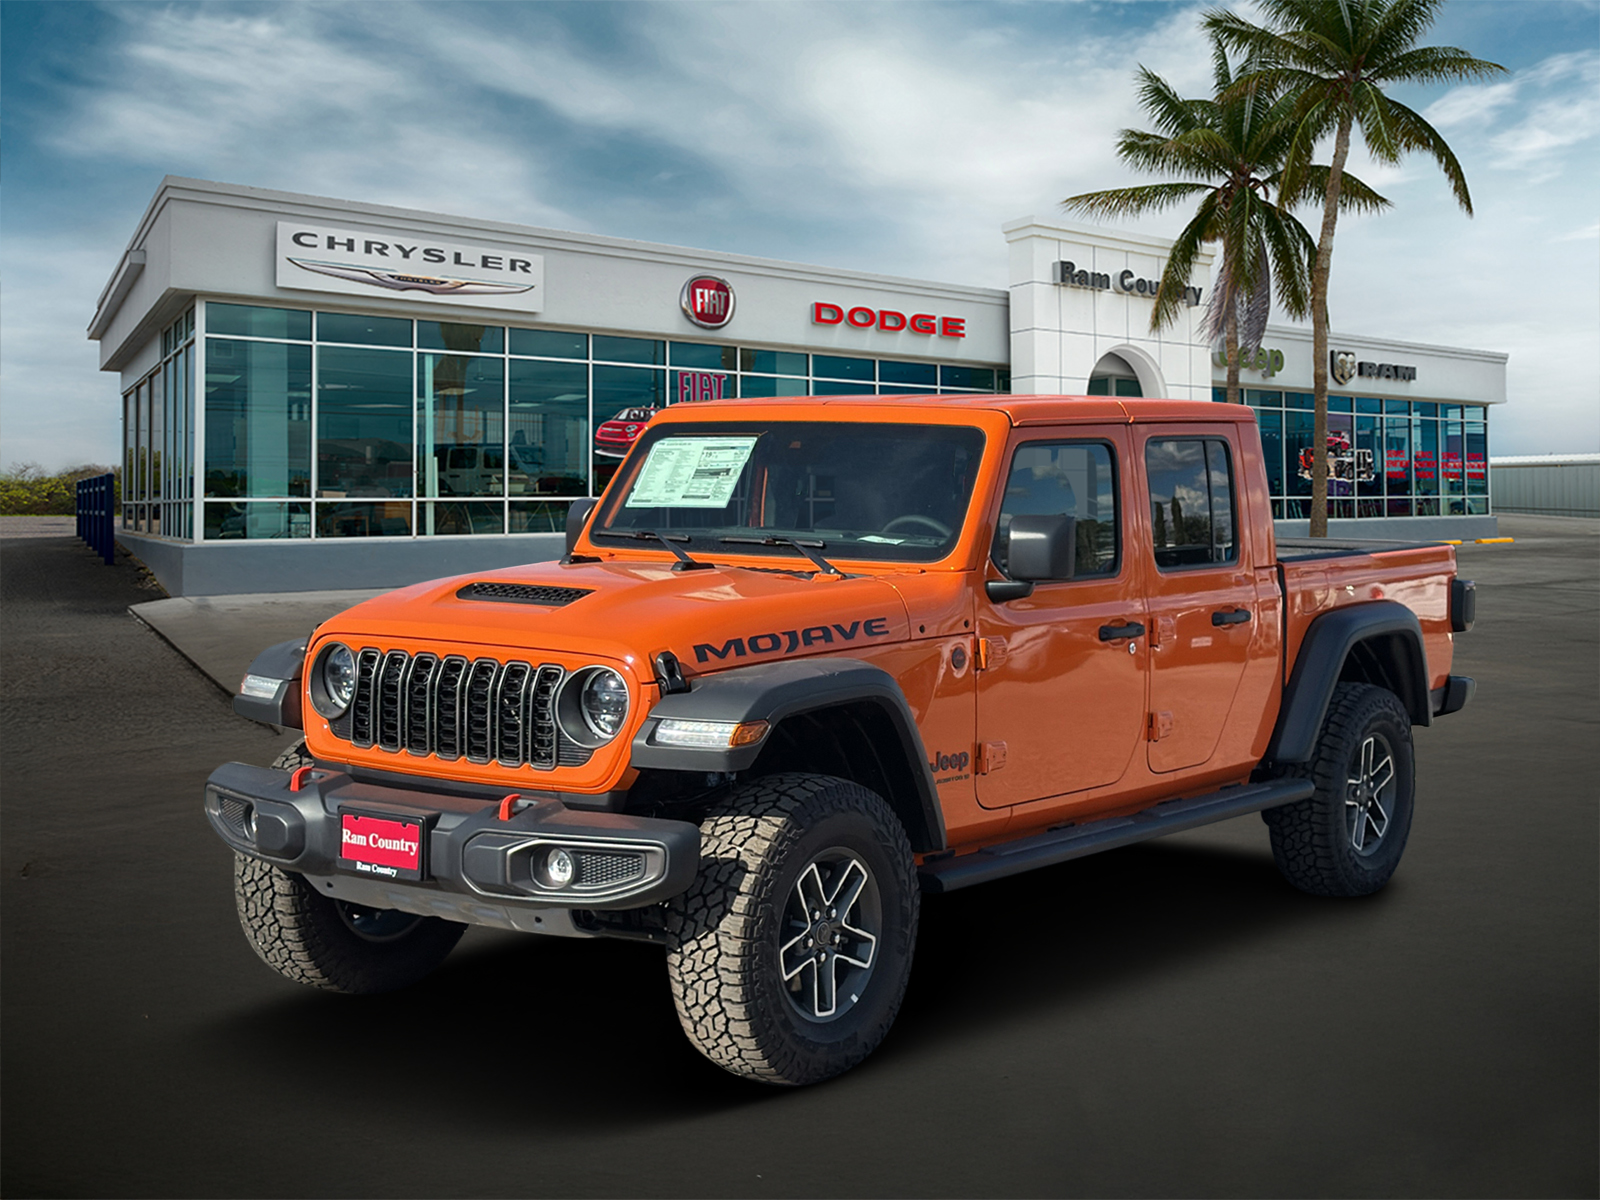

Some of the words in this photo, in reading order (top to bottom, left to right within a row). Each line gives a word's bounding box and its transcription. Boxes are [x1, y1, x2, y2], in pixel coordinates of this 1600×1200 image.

[292, 232, 532, 274] CHRYSLER
[1056, 260, 1110, 290] Ram
[1116, 269, 1203, 306] Coury
[695, 288, 727, 316] FIAT
[812, 302, 966, 338] DODGE
[1358, 361, 1416, 382] RAM
[678, 371, 726, 402] FIAT
[693, 617, 889, 663] MOJAVE
[929, 751, 969, 772] Jeep
[342, 828, 367, 846] Ram
[369, 833, 418, 856] Country
[356, 861, 371, 872] Ram
[371, 864, 397, 878] Country
